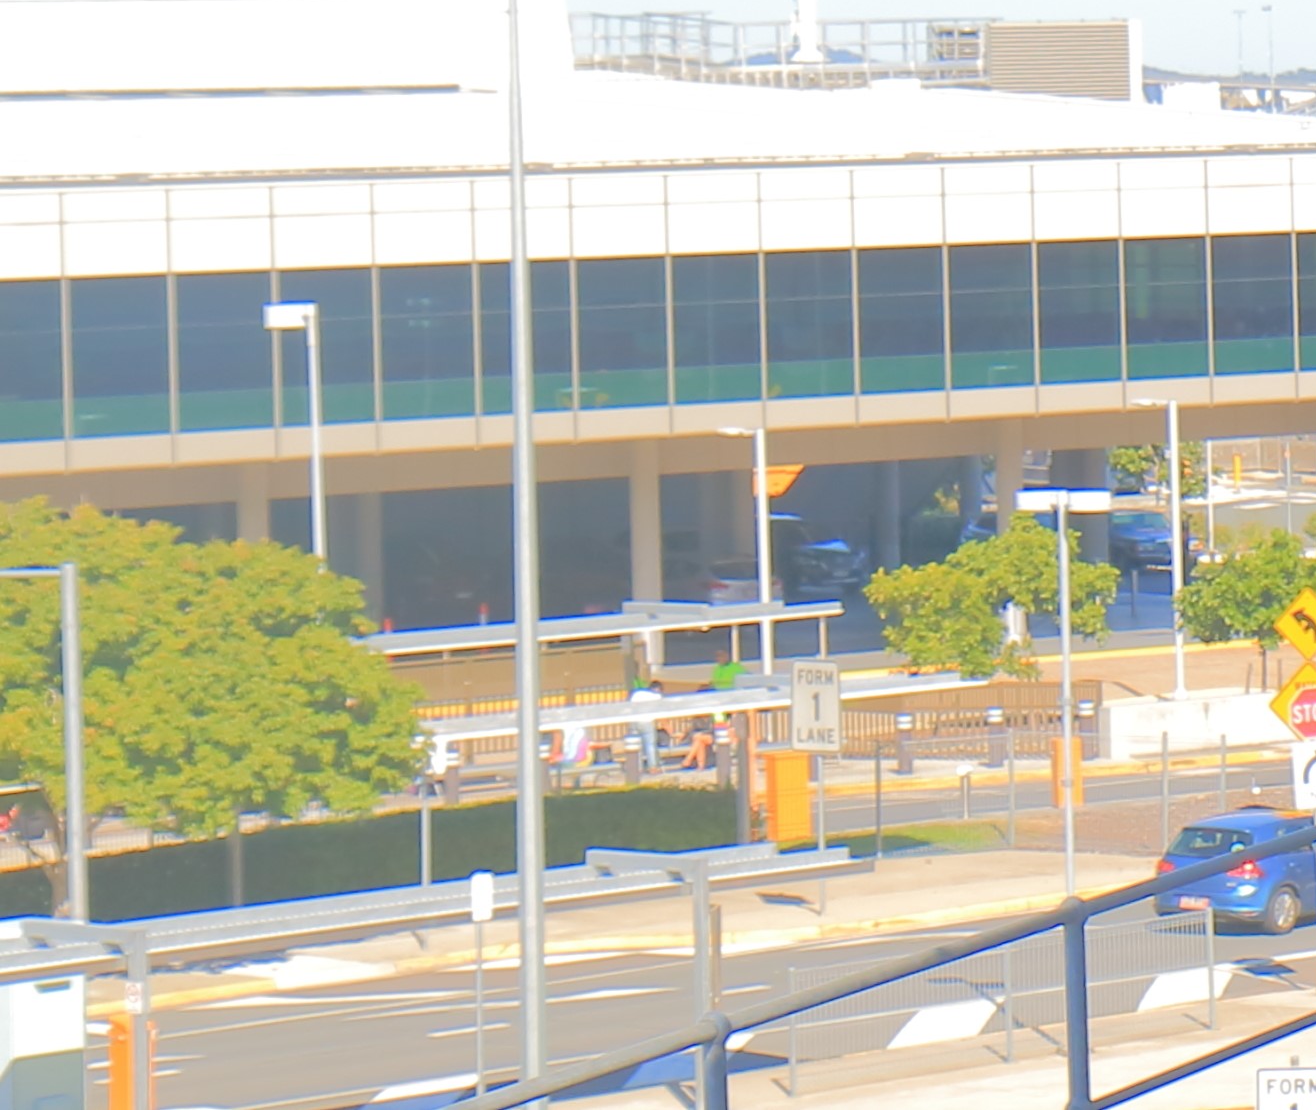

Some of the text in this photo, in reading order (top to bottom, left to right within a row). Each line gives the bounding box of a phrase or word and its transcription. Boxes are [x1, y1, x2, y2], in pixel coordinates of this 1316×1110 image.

[798, 669, 834, 685] FORM
[812, 692, 820, 722] 1
[797, 727, 835, 744] LANE
